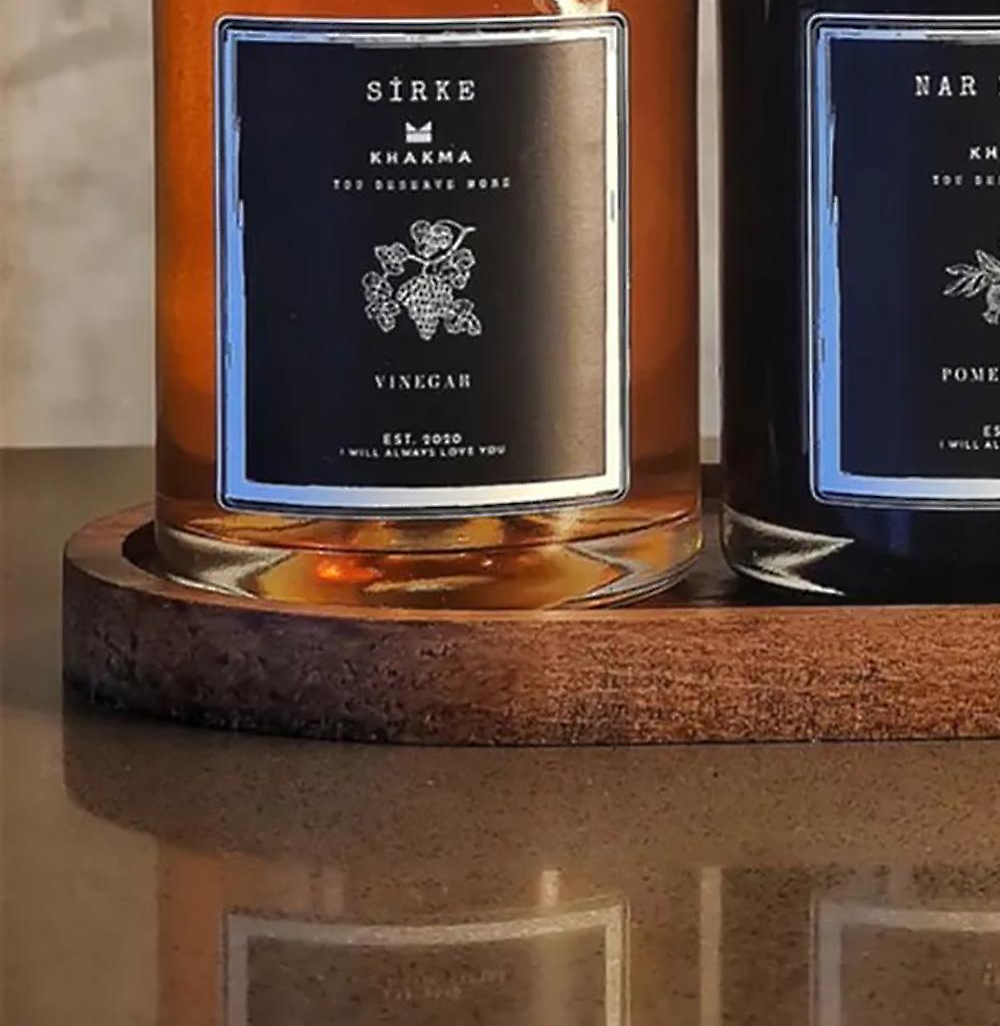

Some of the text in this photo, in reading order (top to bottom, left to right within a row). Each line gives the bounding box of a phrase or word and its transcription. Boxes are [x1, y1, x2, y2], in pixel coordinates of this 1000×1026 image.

[366, 75, 476, 103] SİRKE
[914, 74, 977, 97] NAR
[369, 149, 473, 165] KHAKMA
[373, 373, 472, 390] VINEGAR
[382, 433, 464, 446] EST. 2020
[948, 440, 980, 450] WILL
[348, 447, 380, 458] WILL
[383, 447, 436, 458] ALWAYS
[439, 446, 475, 457] LOVE
[478, 444, 507, 455] YOU
